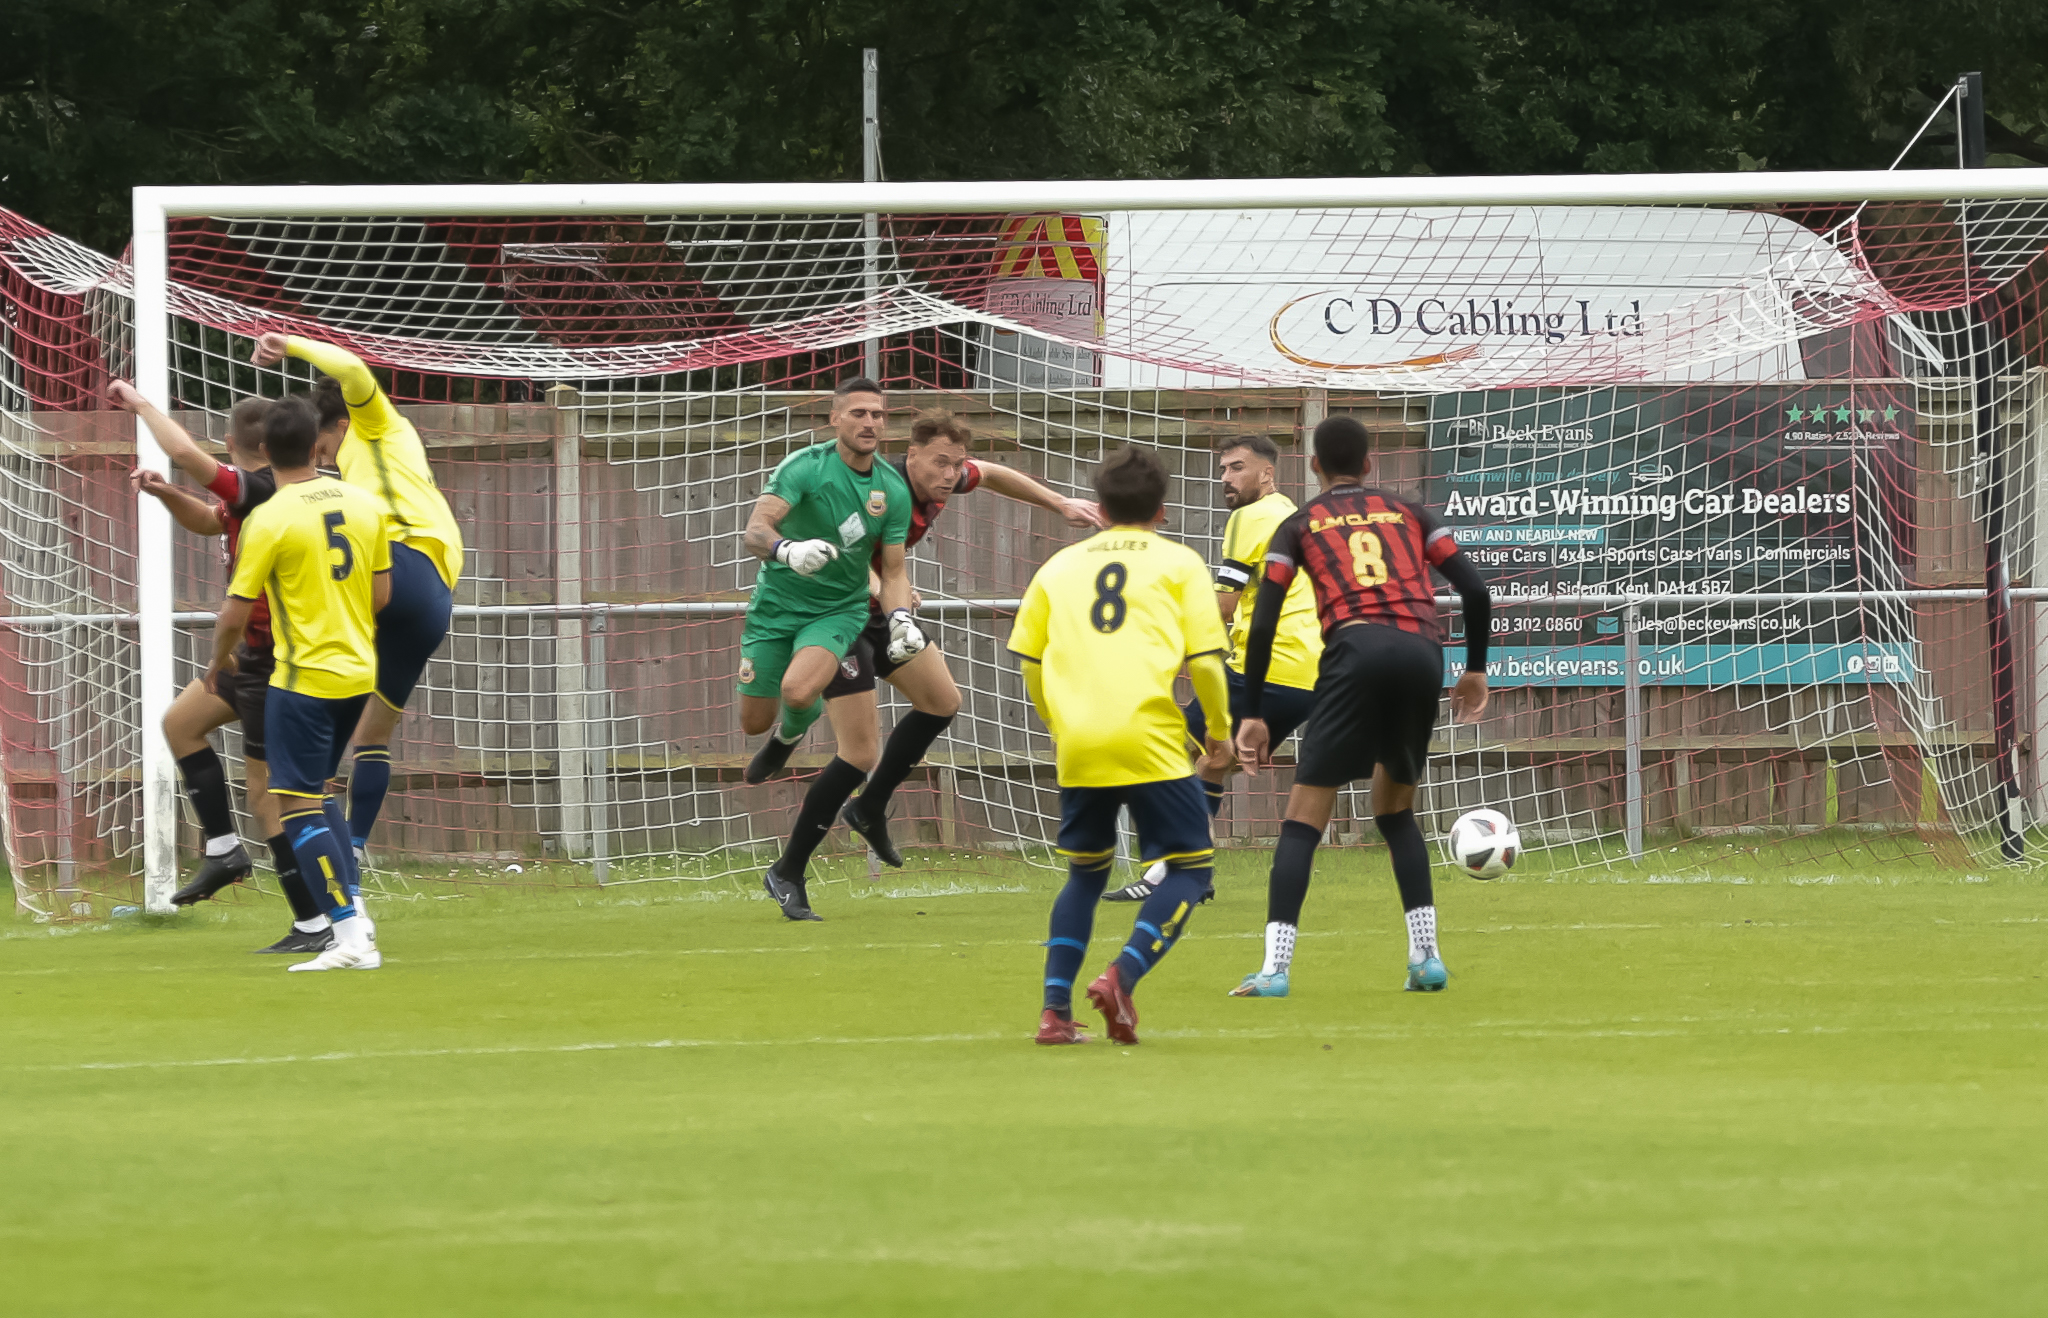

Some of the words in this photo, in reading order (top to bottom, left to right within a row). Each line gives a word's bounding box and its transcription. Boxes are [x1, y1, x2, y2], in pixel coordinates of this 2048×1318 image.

[1324, 298, 1355, 336] C
[1367, 298, 1402, 336] D
[1416, 298, 1565, 345] Cabling
[1575, 299, 1645, 337] Ltd
[1492, 424, 1536, 441] Beck
[1541, 424, 1594, 441] Evans
[1444, 487, 1676, 522] Award-Winning
[1684, 488, 1737, 515] Car
[1741, 485, 1851, 514] Dealers
[322, 509, 354, 582] 5
[1454, 529, 1483, 542] NEW
[1486, 529, 1513, 541] AND
[1516, 528, 1566, 542] NEARLY
[1568, 528, 1598, 541] NEW
[1348, 530, 1389, 588] 8
[1464, 547, 1509, 566] estige
[1512, 547, 1547, 562] Cars
[1559, 547, 1595, 562] 4x4s
[1607, 546, 1656, 565] Sports
[1659, 546, 1694, 562] Cars
[1707, 546, 1743, 561] Vans
[1755, 544, 1851, 561] Commercials
[1090, 561, 1128, 634] 8
[1490, 616, 1510, 633] 08
[1513, 616, 1542, 632] 302
